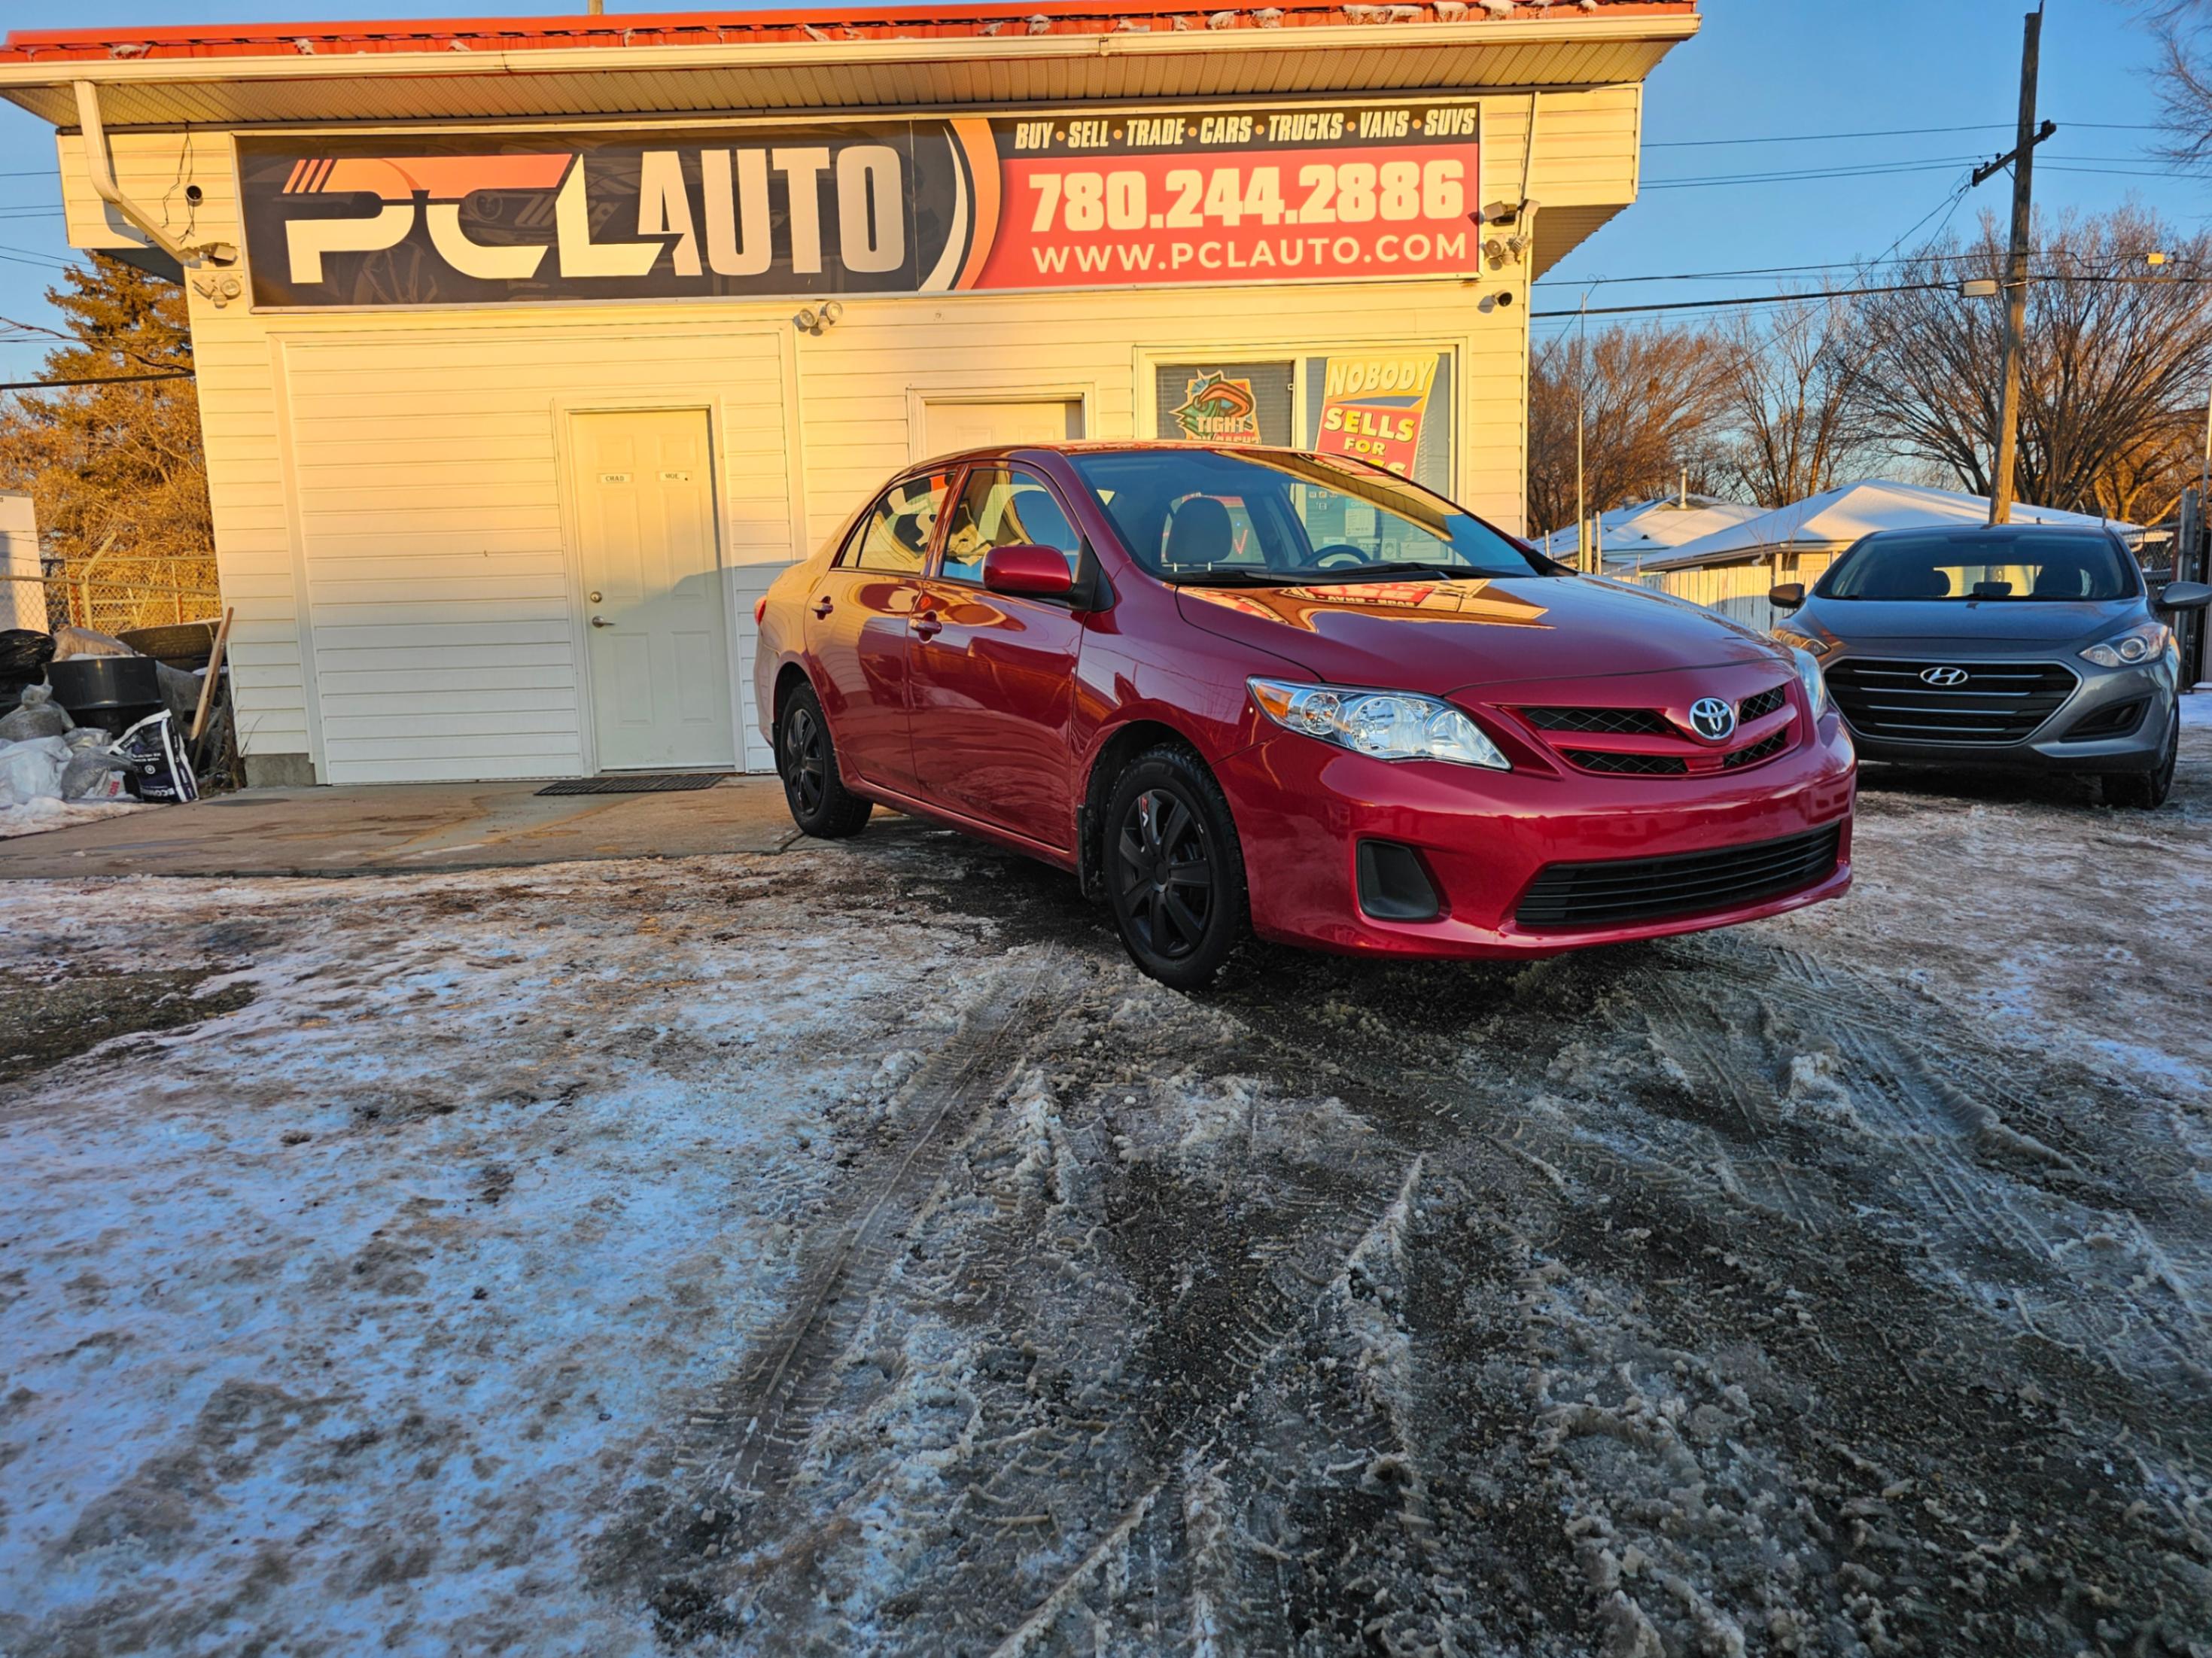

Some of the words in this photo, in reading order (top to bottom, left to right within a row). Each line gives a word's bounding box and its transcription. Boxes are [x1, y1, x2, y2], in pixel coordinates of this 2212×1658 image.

[1015, 122, 1054, 150] BUY
[1067, 120, 1109, 148] SELL
[1126, 118, 1186, 146] TRADE
[1200, 116, 1252, 144] CARS
[1267, 114, 1344, 141] TRUCKS
[1359, 111, 1410, 138] VANS
[1424, 108, 1476, 136] SUVS
[284, 152, 665, 284] PCL
[637, 145, 905, 277] AUTO
[1029, 160, 1465, 233] 780.244.2886
[1031, 233, 1466, 274] WWW.PCLAUTO.COM
[1328, 358, 1435, 397] NOBODY
[1197, 415, 1246, 433] TIGHT
[1324, 407, 1416, 443] SELLS
[1344, 437, 1386, 456] FOR
